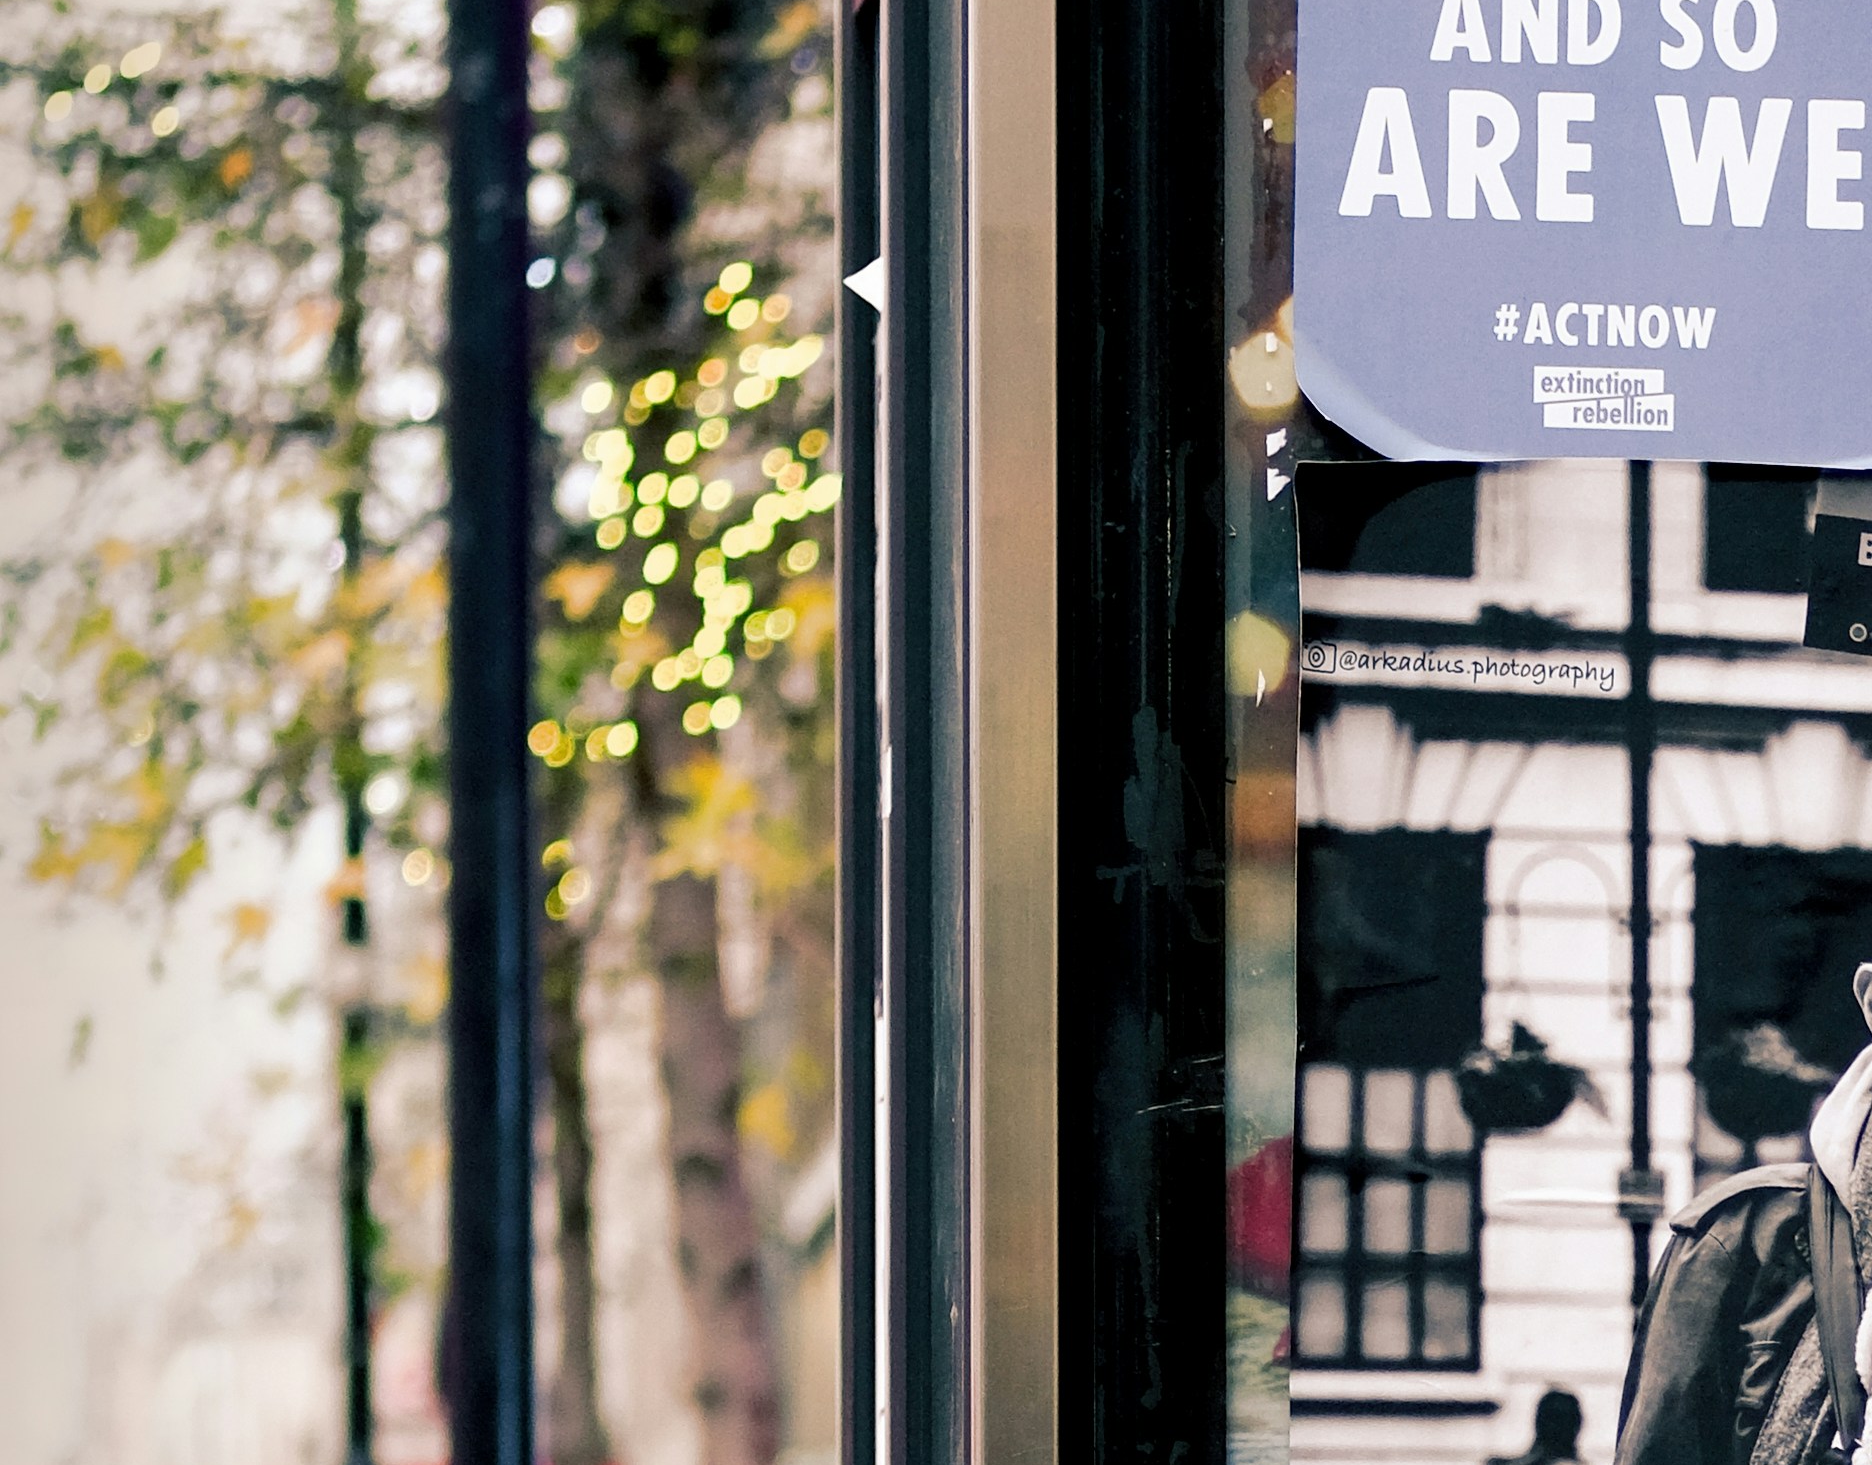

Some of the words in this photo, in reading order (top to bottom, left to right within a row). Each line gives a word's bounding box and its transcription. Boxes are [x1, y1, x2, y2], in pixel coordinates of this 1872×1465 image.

[1338, 86, 1596, 224] ARE
[1654, 94, 1866, 231] WE
[1493, 302, 1717, 349] #ACTNOW
[1540, 370, 1646, 397] extinction
[1571, 396, 1670, 426] rebellion
[1338, 649, 1617, 692] @arkadius.photography
